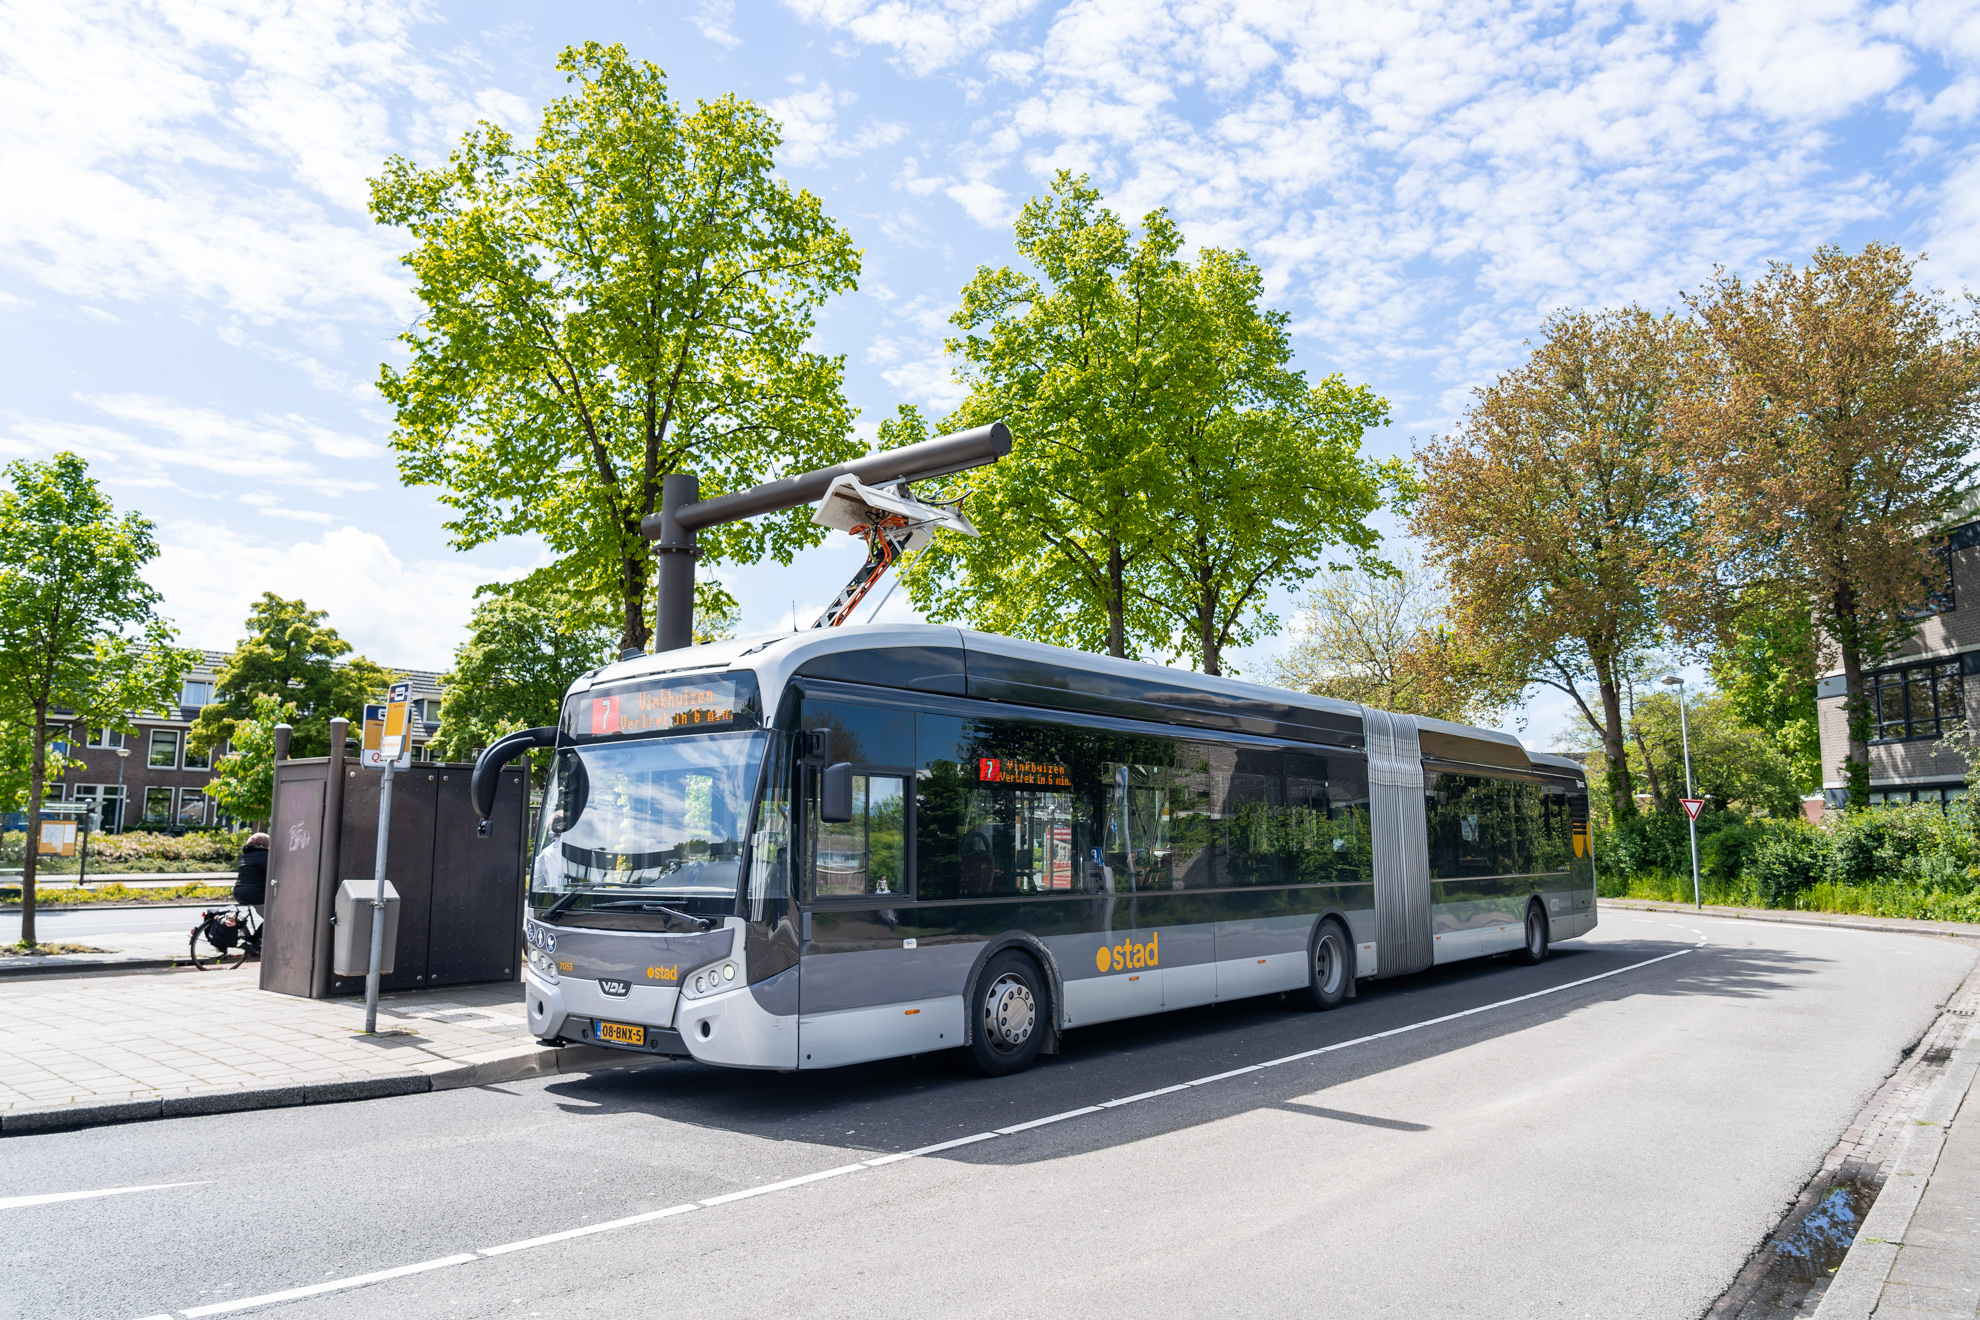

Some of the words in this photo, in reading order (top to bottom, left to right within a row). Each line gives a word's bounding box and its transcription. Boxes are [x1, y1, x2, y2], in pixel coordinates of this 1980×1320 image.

[638, 689, 713, 711] Vinkhuizen
[602, 699, 610, 731] 7
[620, 712, 669, 731] Vertrek
[674, 710, 687, 725] in
[694, 708, 701, 723] 6
[707, 706, 734, 722] min.
[986, 760, 993, 779] 7
[1007, 760, 1065, 775] Vinkhuizen
[1000, 771, 1035, 784] Vertrek
[1037, 774, 1046, 785] in
[1048, 774, 1053, 785] 6
[1055, 775, 1072, 786] min.
[1113, 932, 1159, 970] stad
[559, 962, 573, 971] 7053
[654, 965, 677, 980] stad
[601, 981, 627, 994] VDL
[602, 1024, 642, 1042] 08-BNX-5
